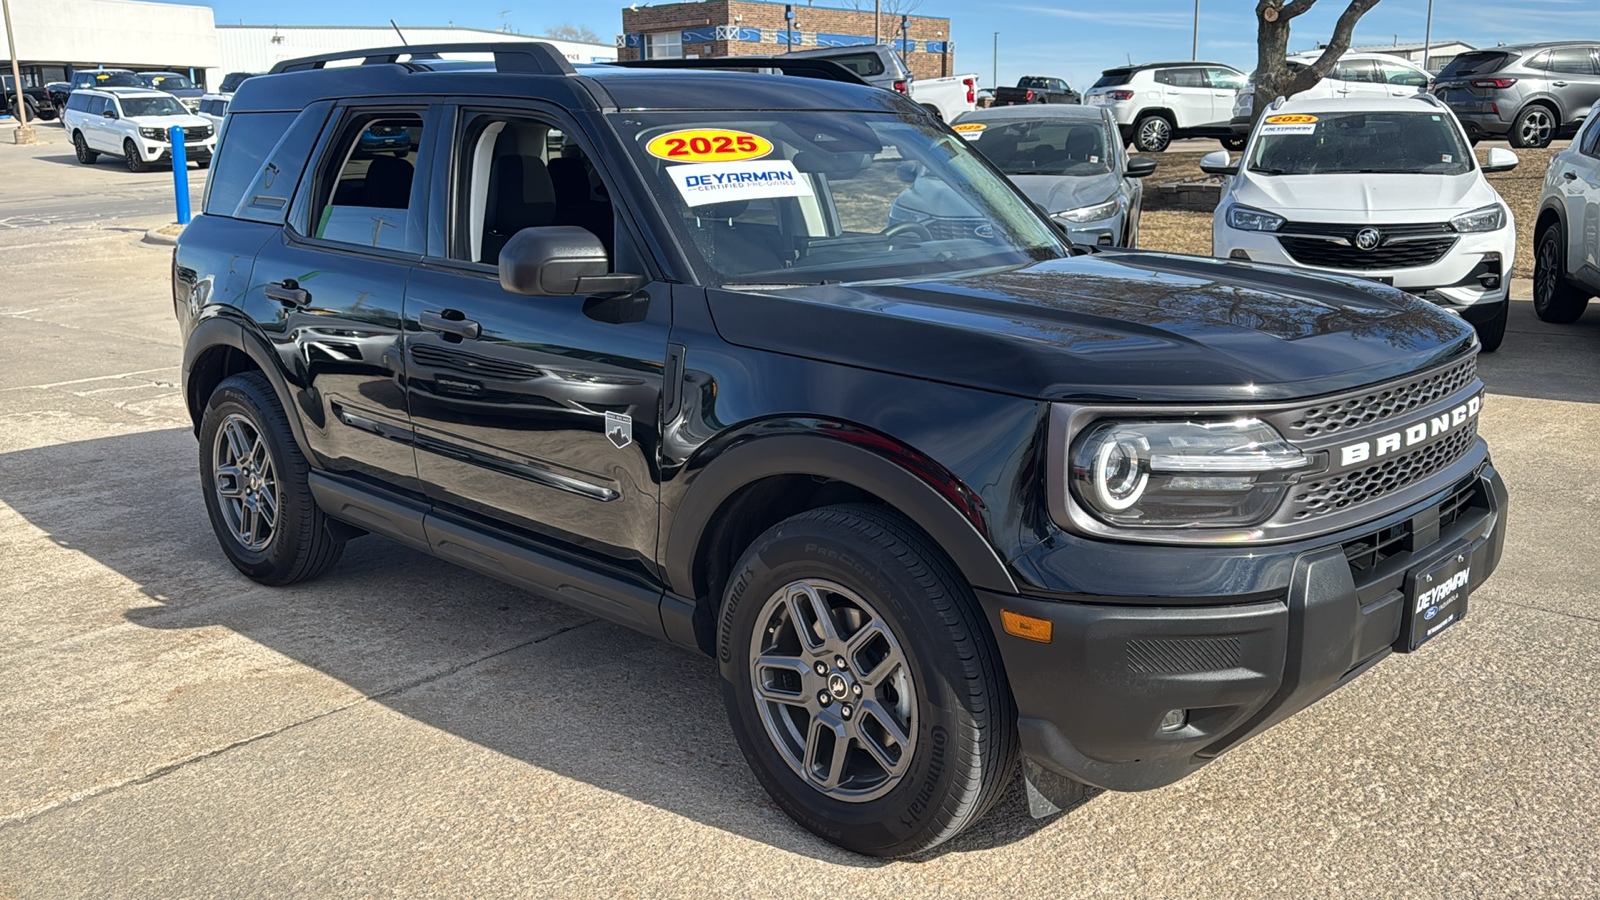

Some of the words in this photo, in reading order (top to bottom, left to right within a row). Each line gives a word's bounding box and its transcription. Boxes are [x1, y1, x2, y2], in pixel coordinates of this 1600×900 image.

[664, 136, 758, 157] 2025
[685, 171, 794, 188] DEYARMAN
[697, 182, 744, 192] CERTIFIED
[746, 180, 796, 188] PRE-OWNED
[1341, 396, 1480, 467] BRONCO
[1416, 567, 1470, 614] DEYARMAN
[720, 573, 749, 664] Continental
[906, 725, 950, 822] Continental
